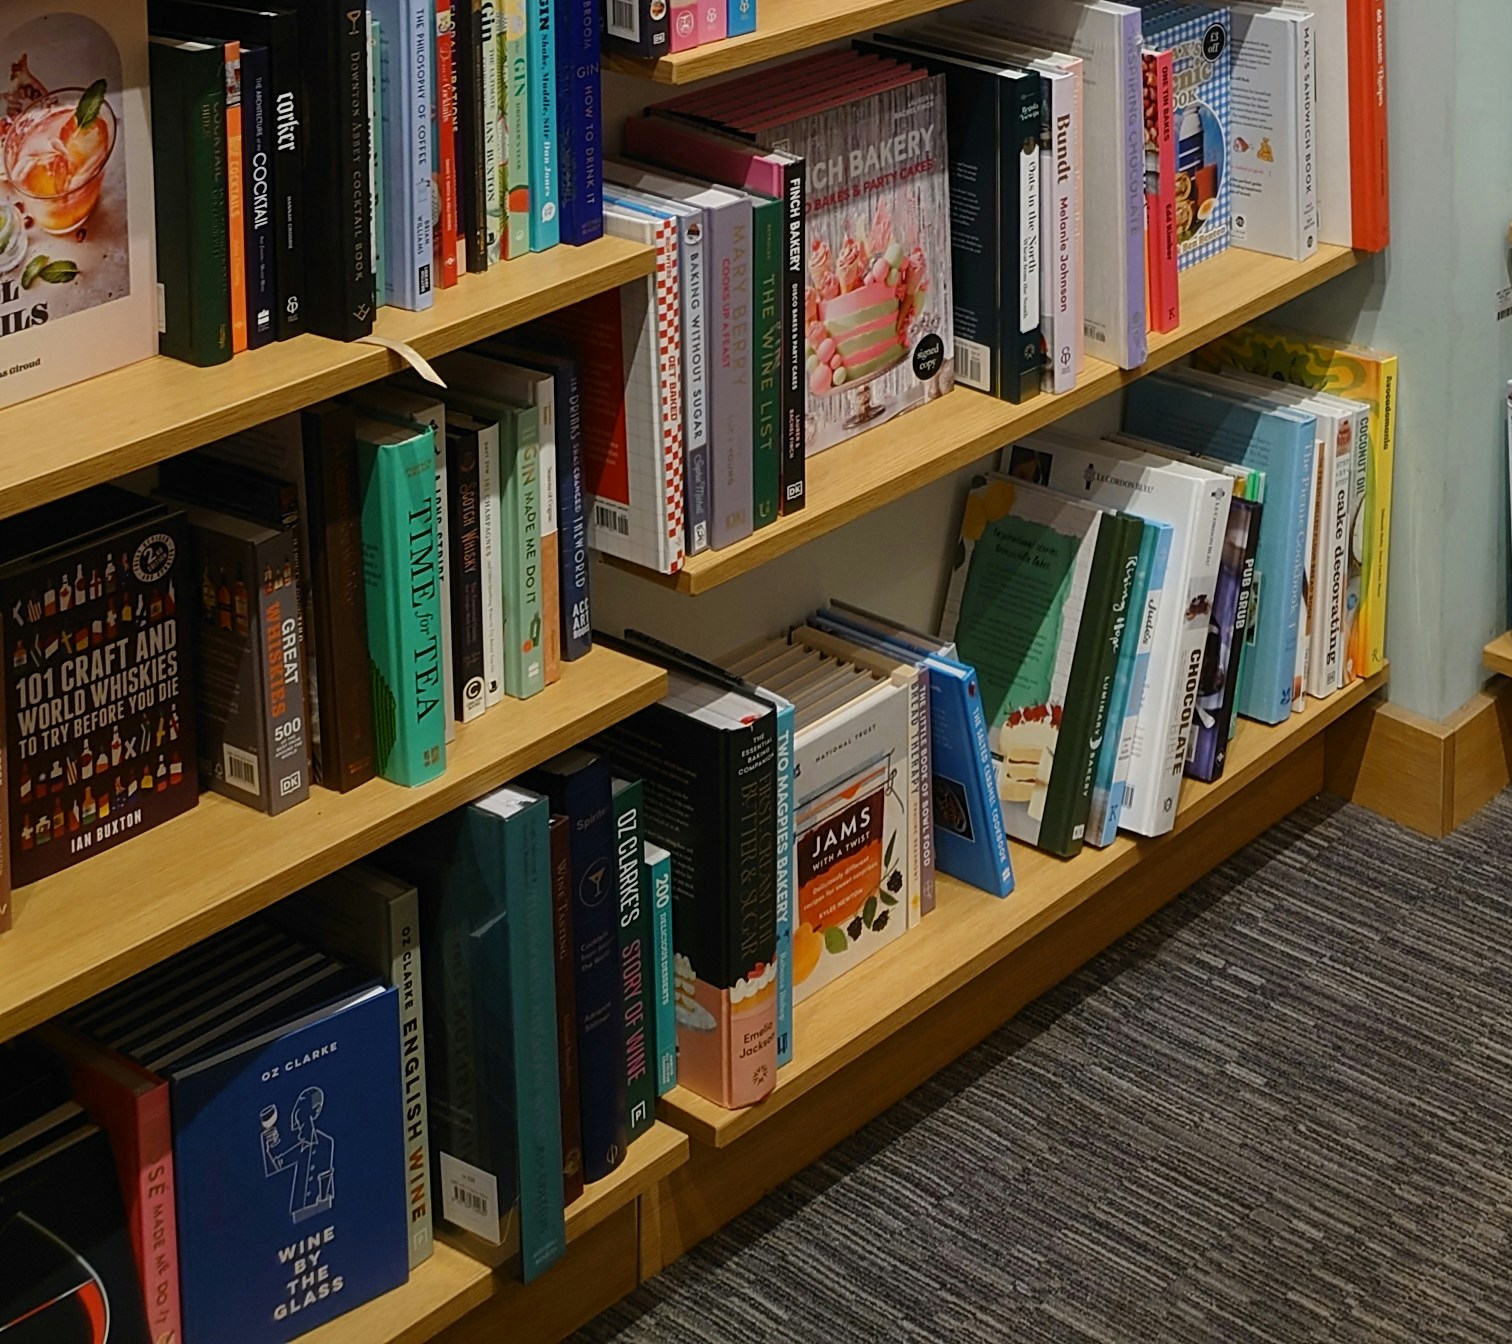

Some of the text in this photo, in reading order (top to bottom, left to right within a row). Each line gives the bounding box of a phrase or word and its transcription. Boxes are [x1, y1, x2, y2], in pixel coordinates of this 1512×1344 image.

[849, 125, 936, 178] BAKERY
[1057, 114, 1070, 184] Bundt
[411, 498, 441, 723] TIME for TEA
[17, 620, 177, 708] 101 CRAFT AND
[19, 652, 178, 737] WORLD WHISKIES
[19, 677, 179, 759] TO TRY BEFORE YOU DIE
[1172, 648, 1202, 777] CHOCOLATE
[70, 809, 142, 854] IAN BUXTON
[812, 806, 871, 858] JAMS
[262, 1042, 337, 1082] OZ CLARKE
[278, 1226, 336, 1263] WINE
[294, 1250, 320, 1276] BY
[274, 1277, 343, 1321] GLASS
[286, 1265, 330, 1295] THE
